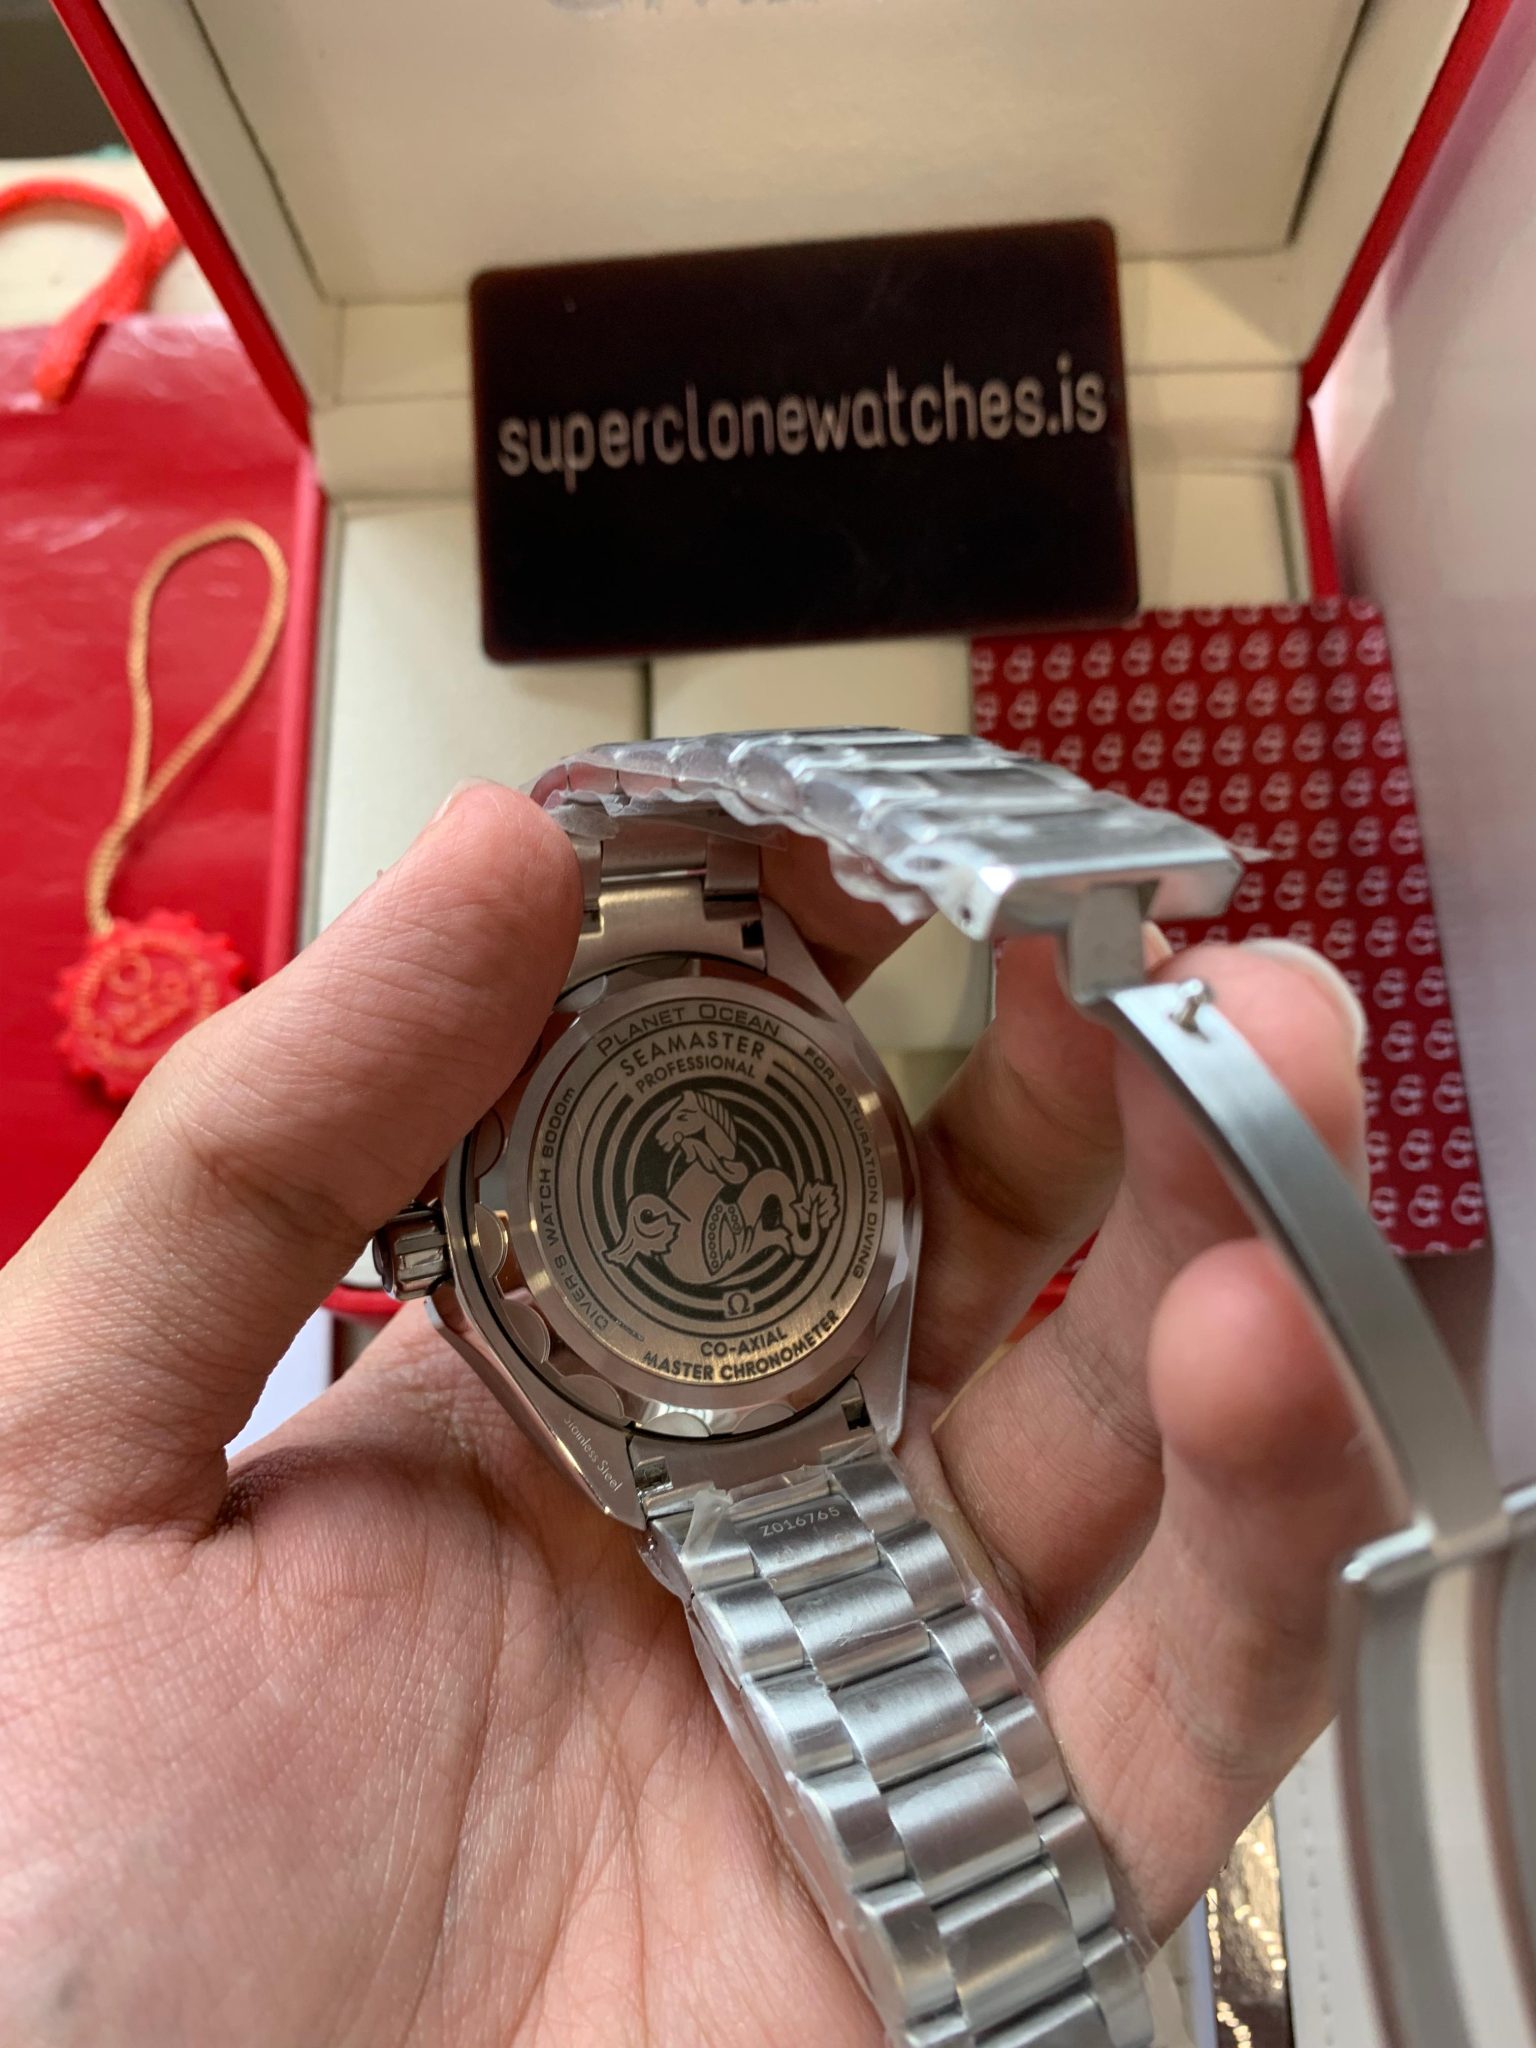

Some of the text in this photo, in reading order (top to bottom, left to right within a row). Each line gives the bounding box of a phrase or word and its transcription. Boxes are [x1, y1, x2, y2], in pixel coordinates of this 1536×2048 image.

[499, 352, 1107, 494] superclonewatches.is
[596, 1003, 781, 1056] PLANET OCEAN
[620, 1030, 766, 1077] SEAMASTER
[635, 1054, 757, 1094] PROFESSIONAL
[805, 1046, 878, 1280] FOR SATURATION DIVING
[539, 1168, 559, 1247] WATCH
[554, 1255, 609, 1331] DIVER'S
[643, 1309, 840, 1382] MASTER CHRONOMETER
[701, 1326, 788, 1357] CO-AXIAL
[597, 1459, 623, 1492] Steel
